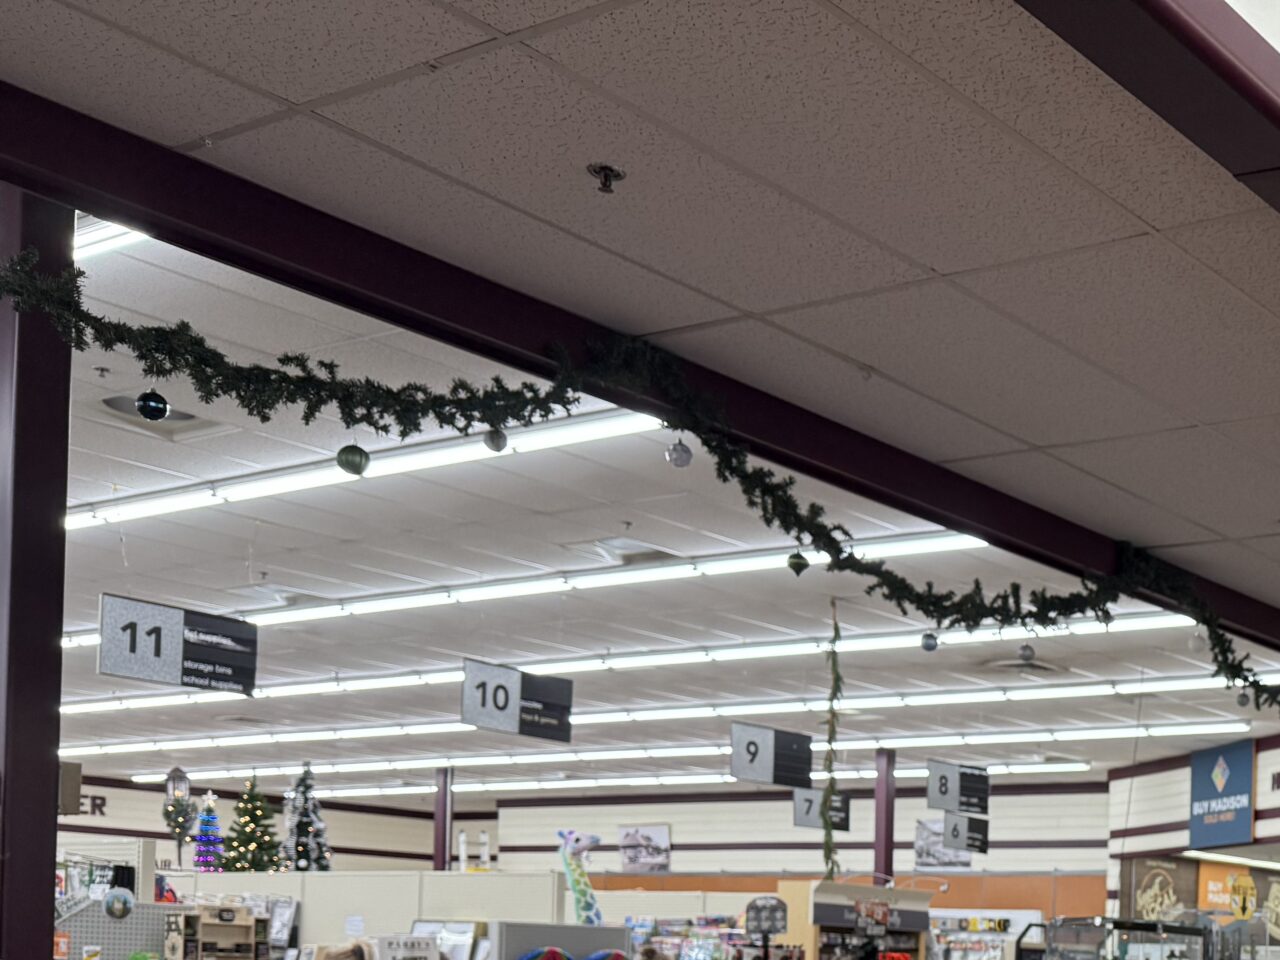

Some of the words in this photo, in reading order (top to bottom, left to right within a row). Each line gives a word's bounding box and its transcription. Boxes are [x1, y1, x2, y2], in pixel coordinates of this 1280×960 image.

[120, 621, 162, 658] 11
[183, 660, 214, 673] storage
[475, 681, 509, 711] 10
[746, 741, 759, 763] 9
[938, 775, 948, 796] 8
[804, 798, 813, 816] 7
[1192, 799, 1210, 816] BUY
[1210, 793, 1249, 813] MADISON
[951, 824, 960, 839] 6
